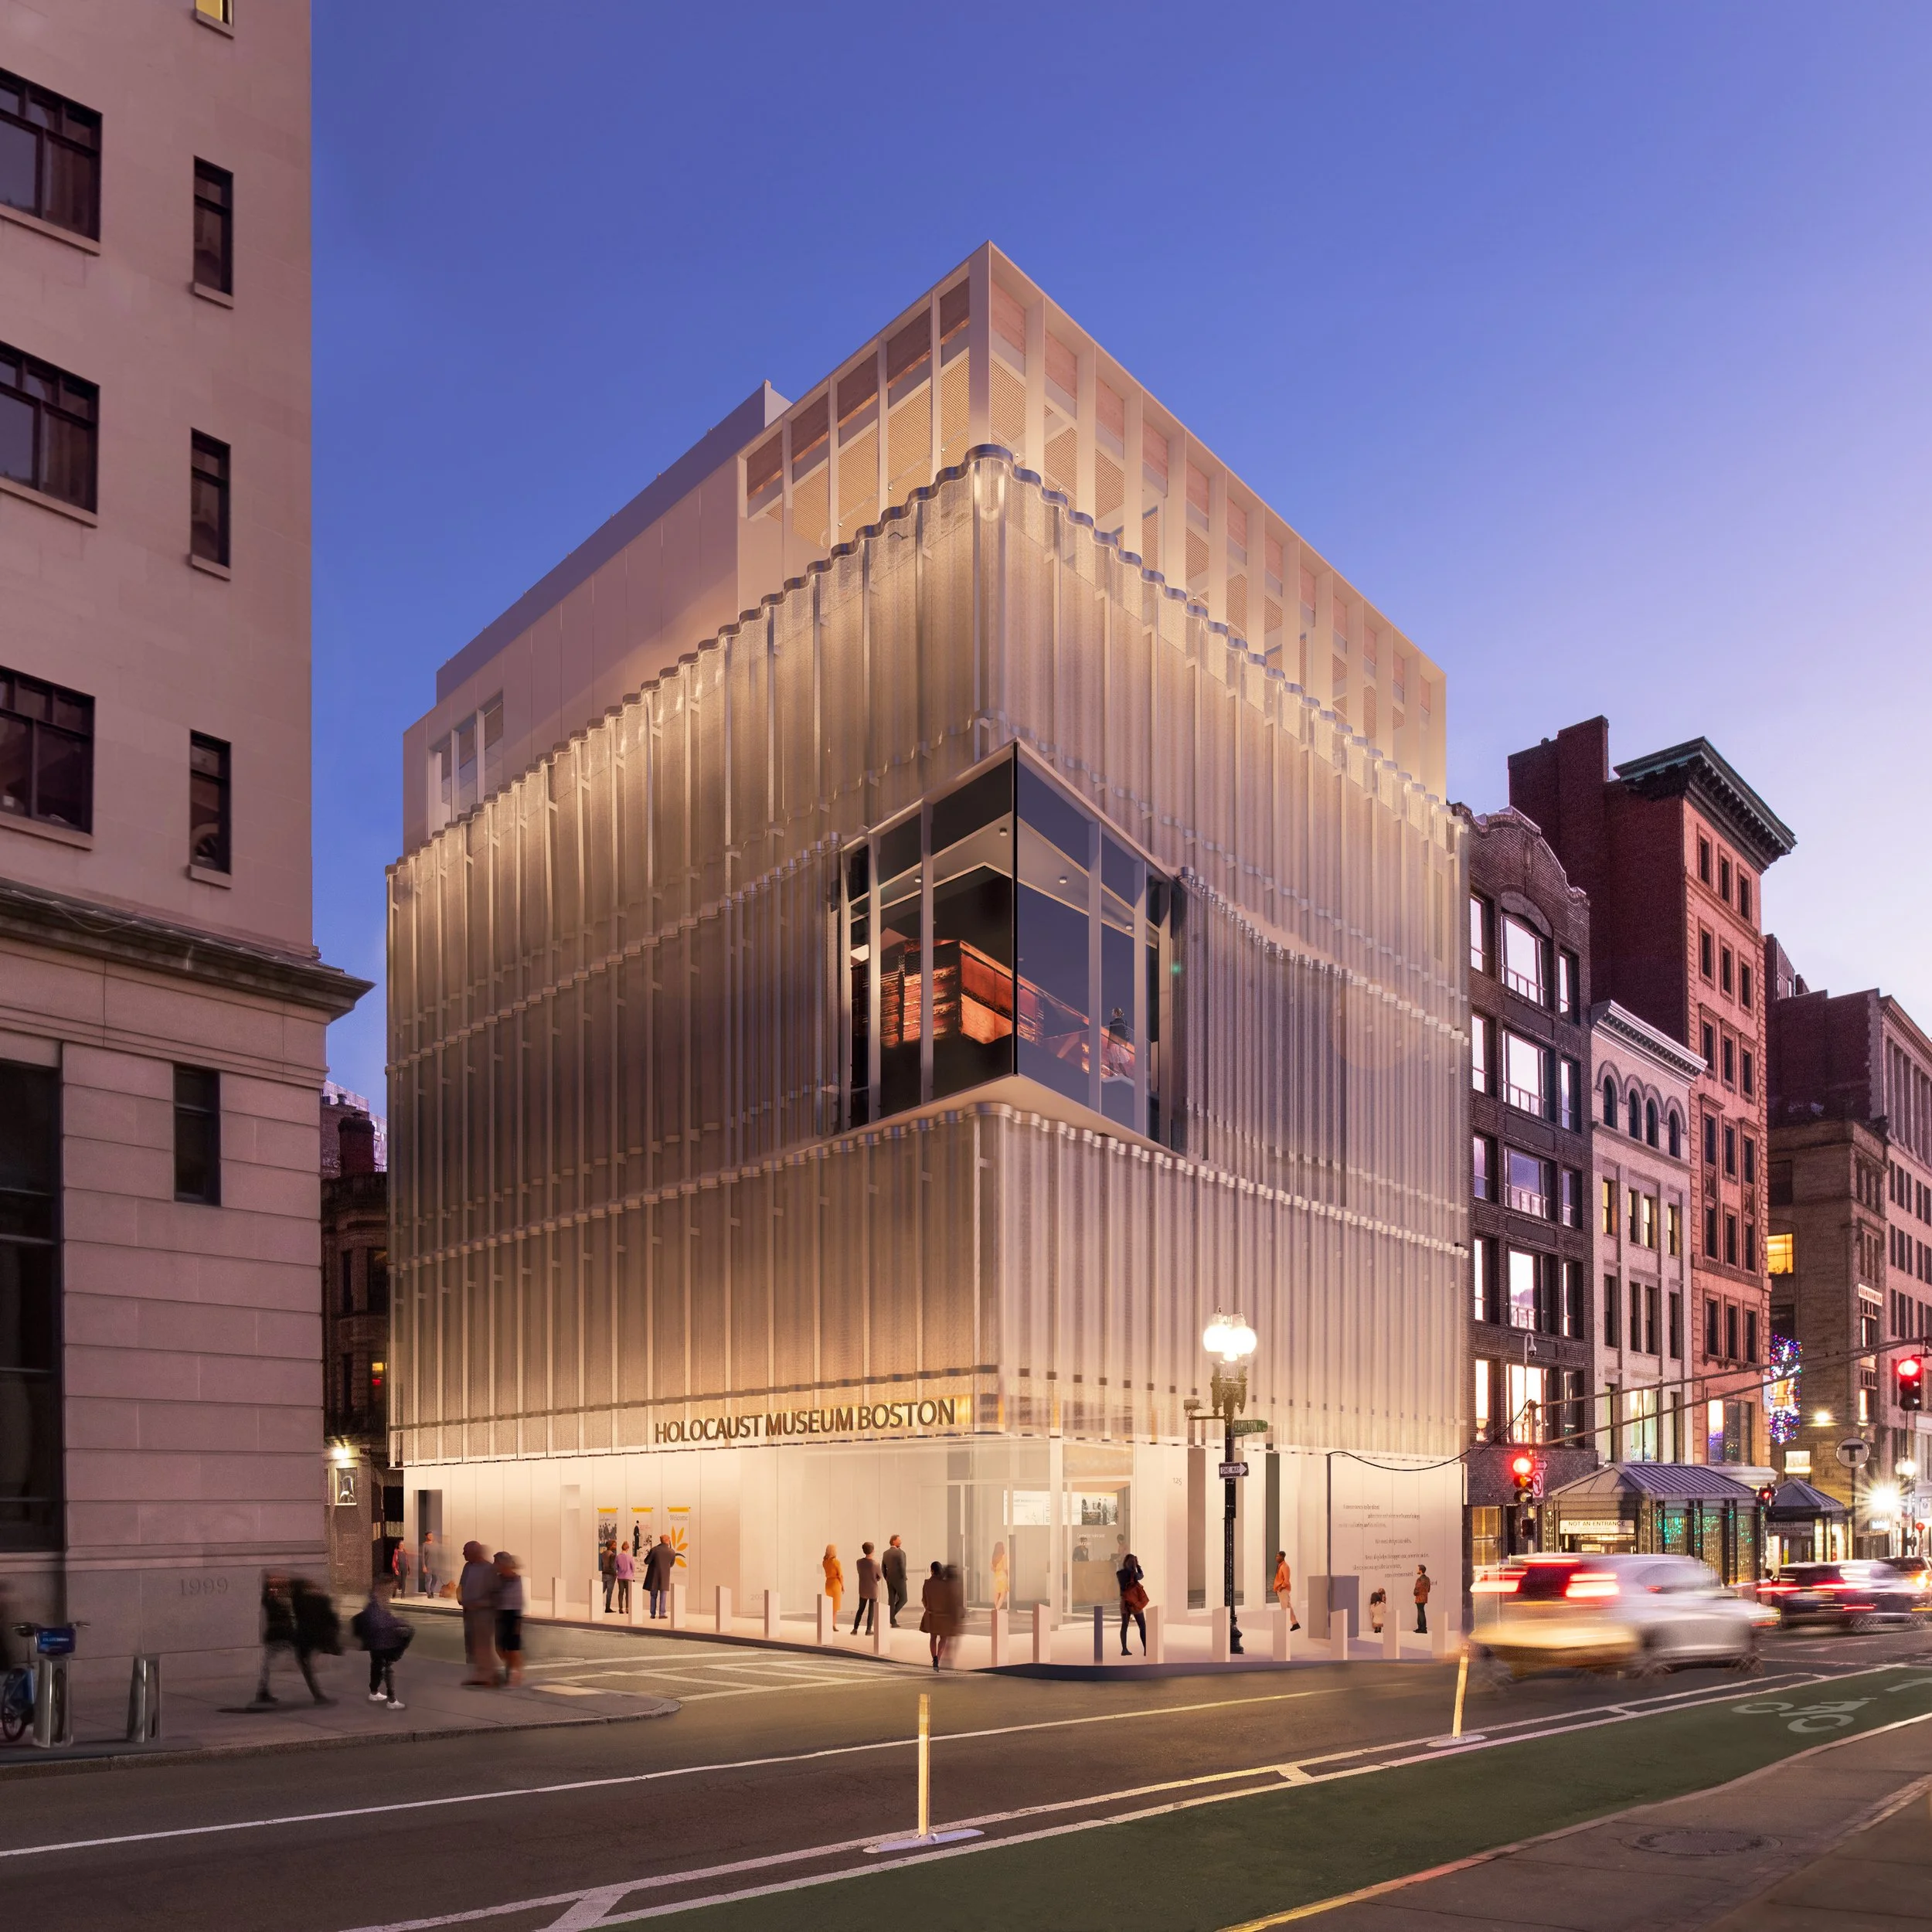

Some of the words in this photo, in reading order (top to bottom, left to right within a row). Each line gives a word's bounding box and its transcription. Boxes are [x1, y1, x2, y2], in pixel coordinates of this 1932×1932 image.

[655, 1414, 763, 1444] HOLOCAUST
[765, 1407, 853, 1437] MUSEUM
[858, 1398, 955, 1430] BOSTON
[1842, 1444, 1863, 1461] T
[1172, 1477, 1182, 1486] 125
